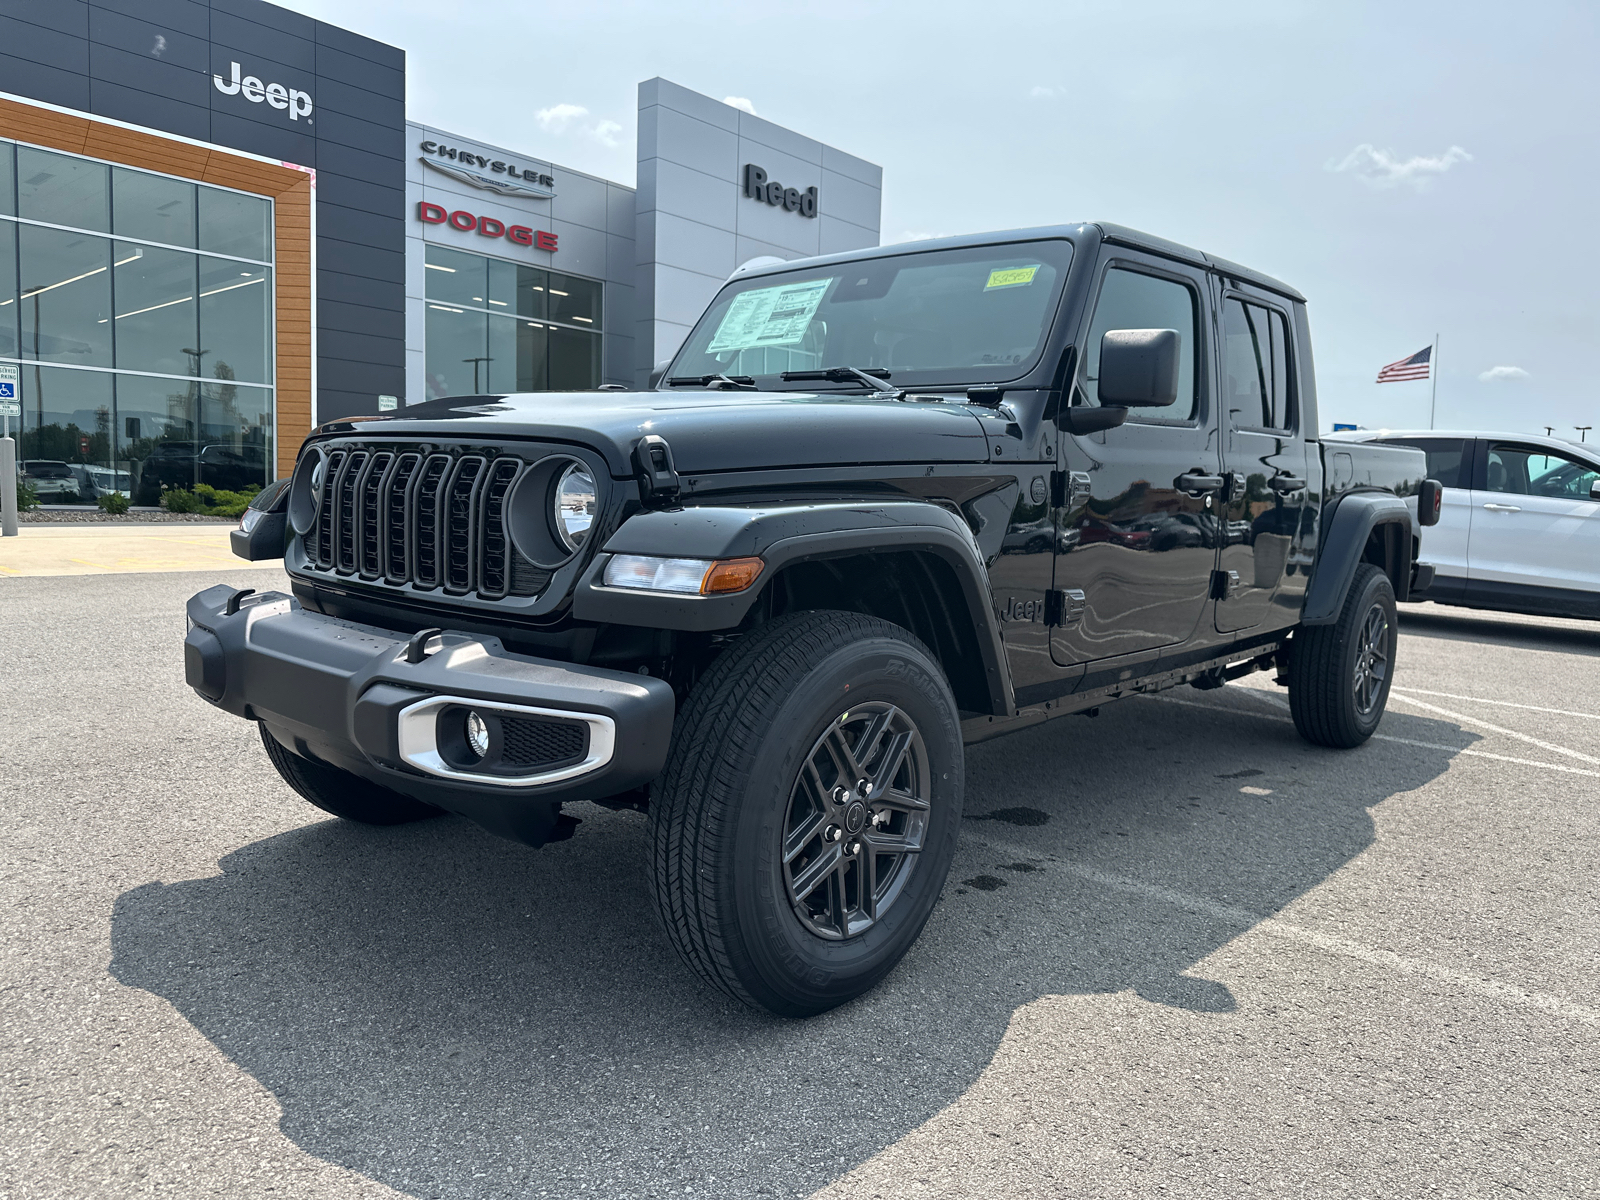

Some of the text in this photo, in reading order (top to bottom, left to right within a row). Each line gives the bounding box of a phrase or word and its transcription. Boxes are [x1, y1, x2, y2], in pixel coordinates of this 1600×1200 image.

[213, 61, 313, 121] Jeep
[420, 140, 555, 187] CHRYSLER
[745, 163, 818, 218] Reed
[418, 201, 559, 252] DODGE
[1001, 596, 1043, 623] Jeep
